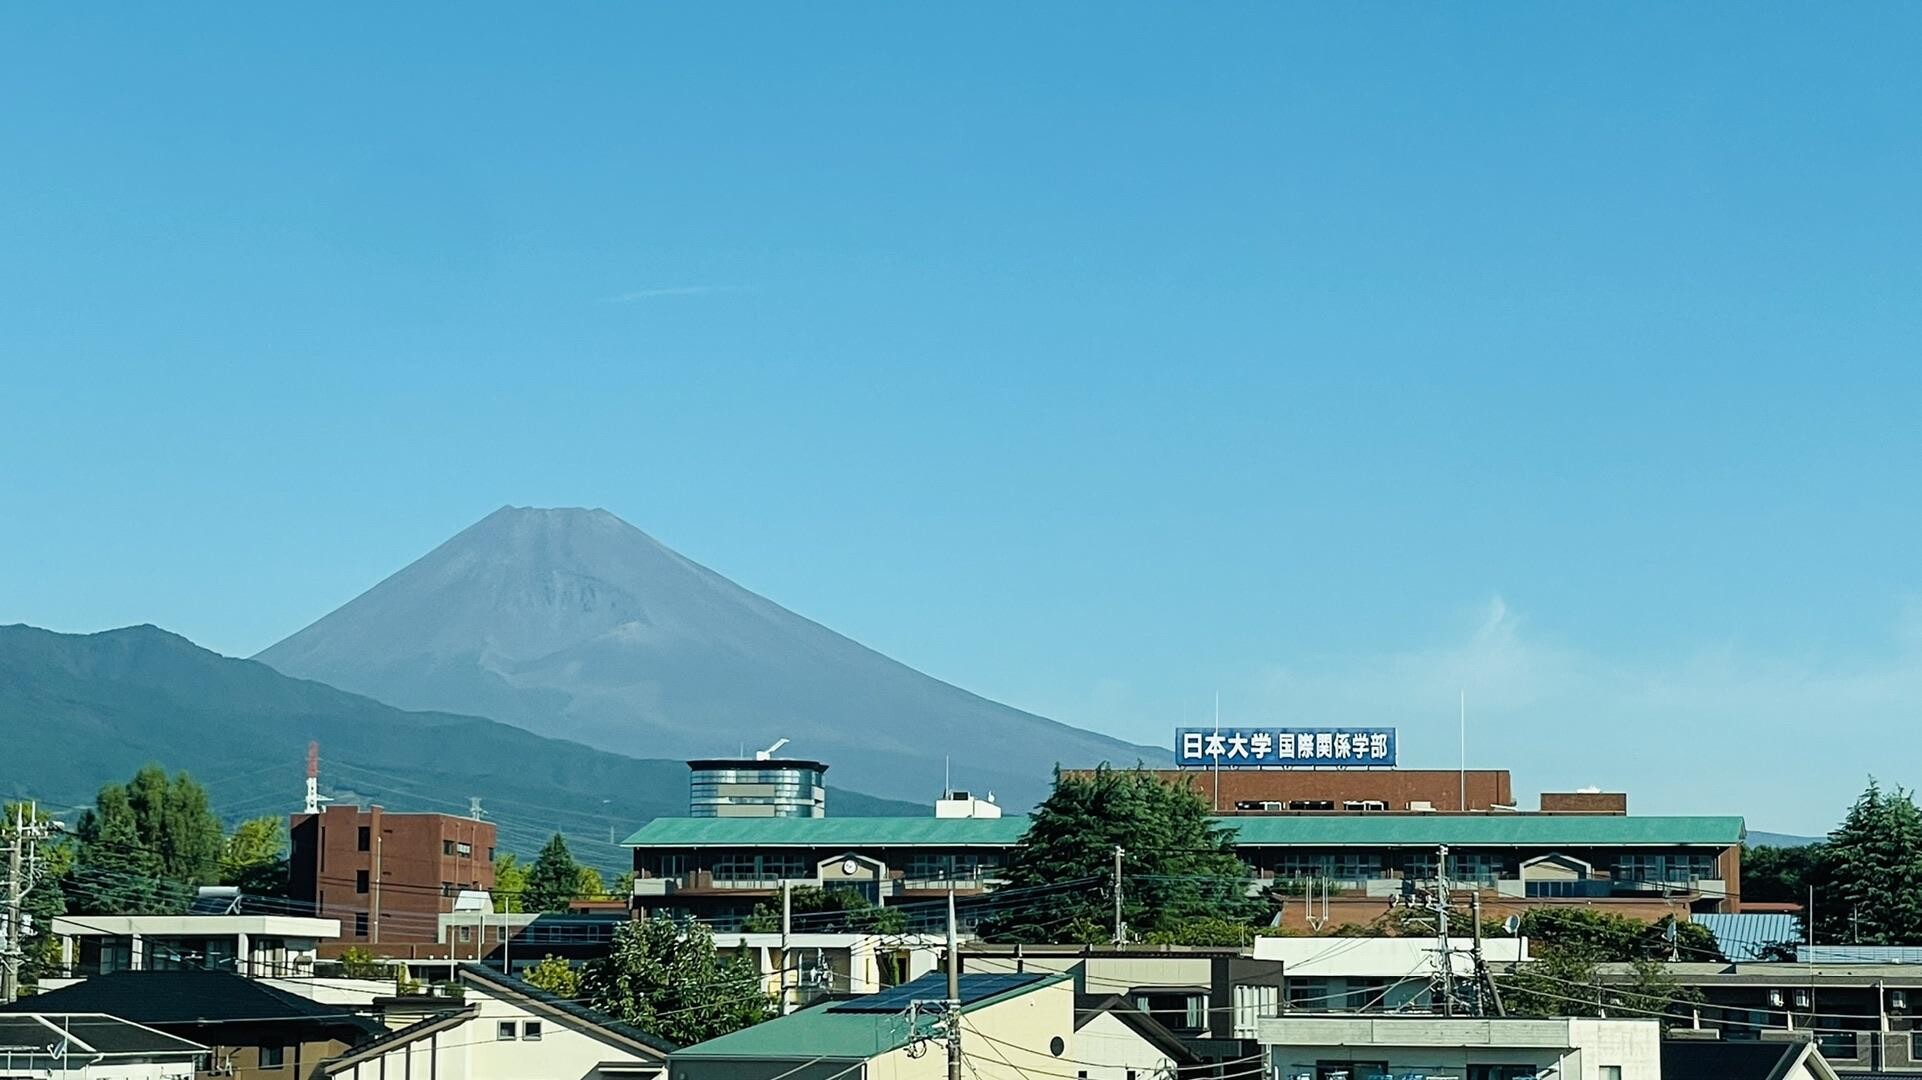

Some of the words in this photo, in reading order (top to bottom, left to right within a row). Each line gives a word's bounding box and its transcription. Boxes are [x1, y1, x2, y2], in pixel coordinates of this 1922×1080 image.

[1183, 732, 1272, 759] 日本大学
[1279, 733, 1388, 759] 国際関係学部
